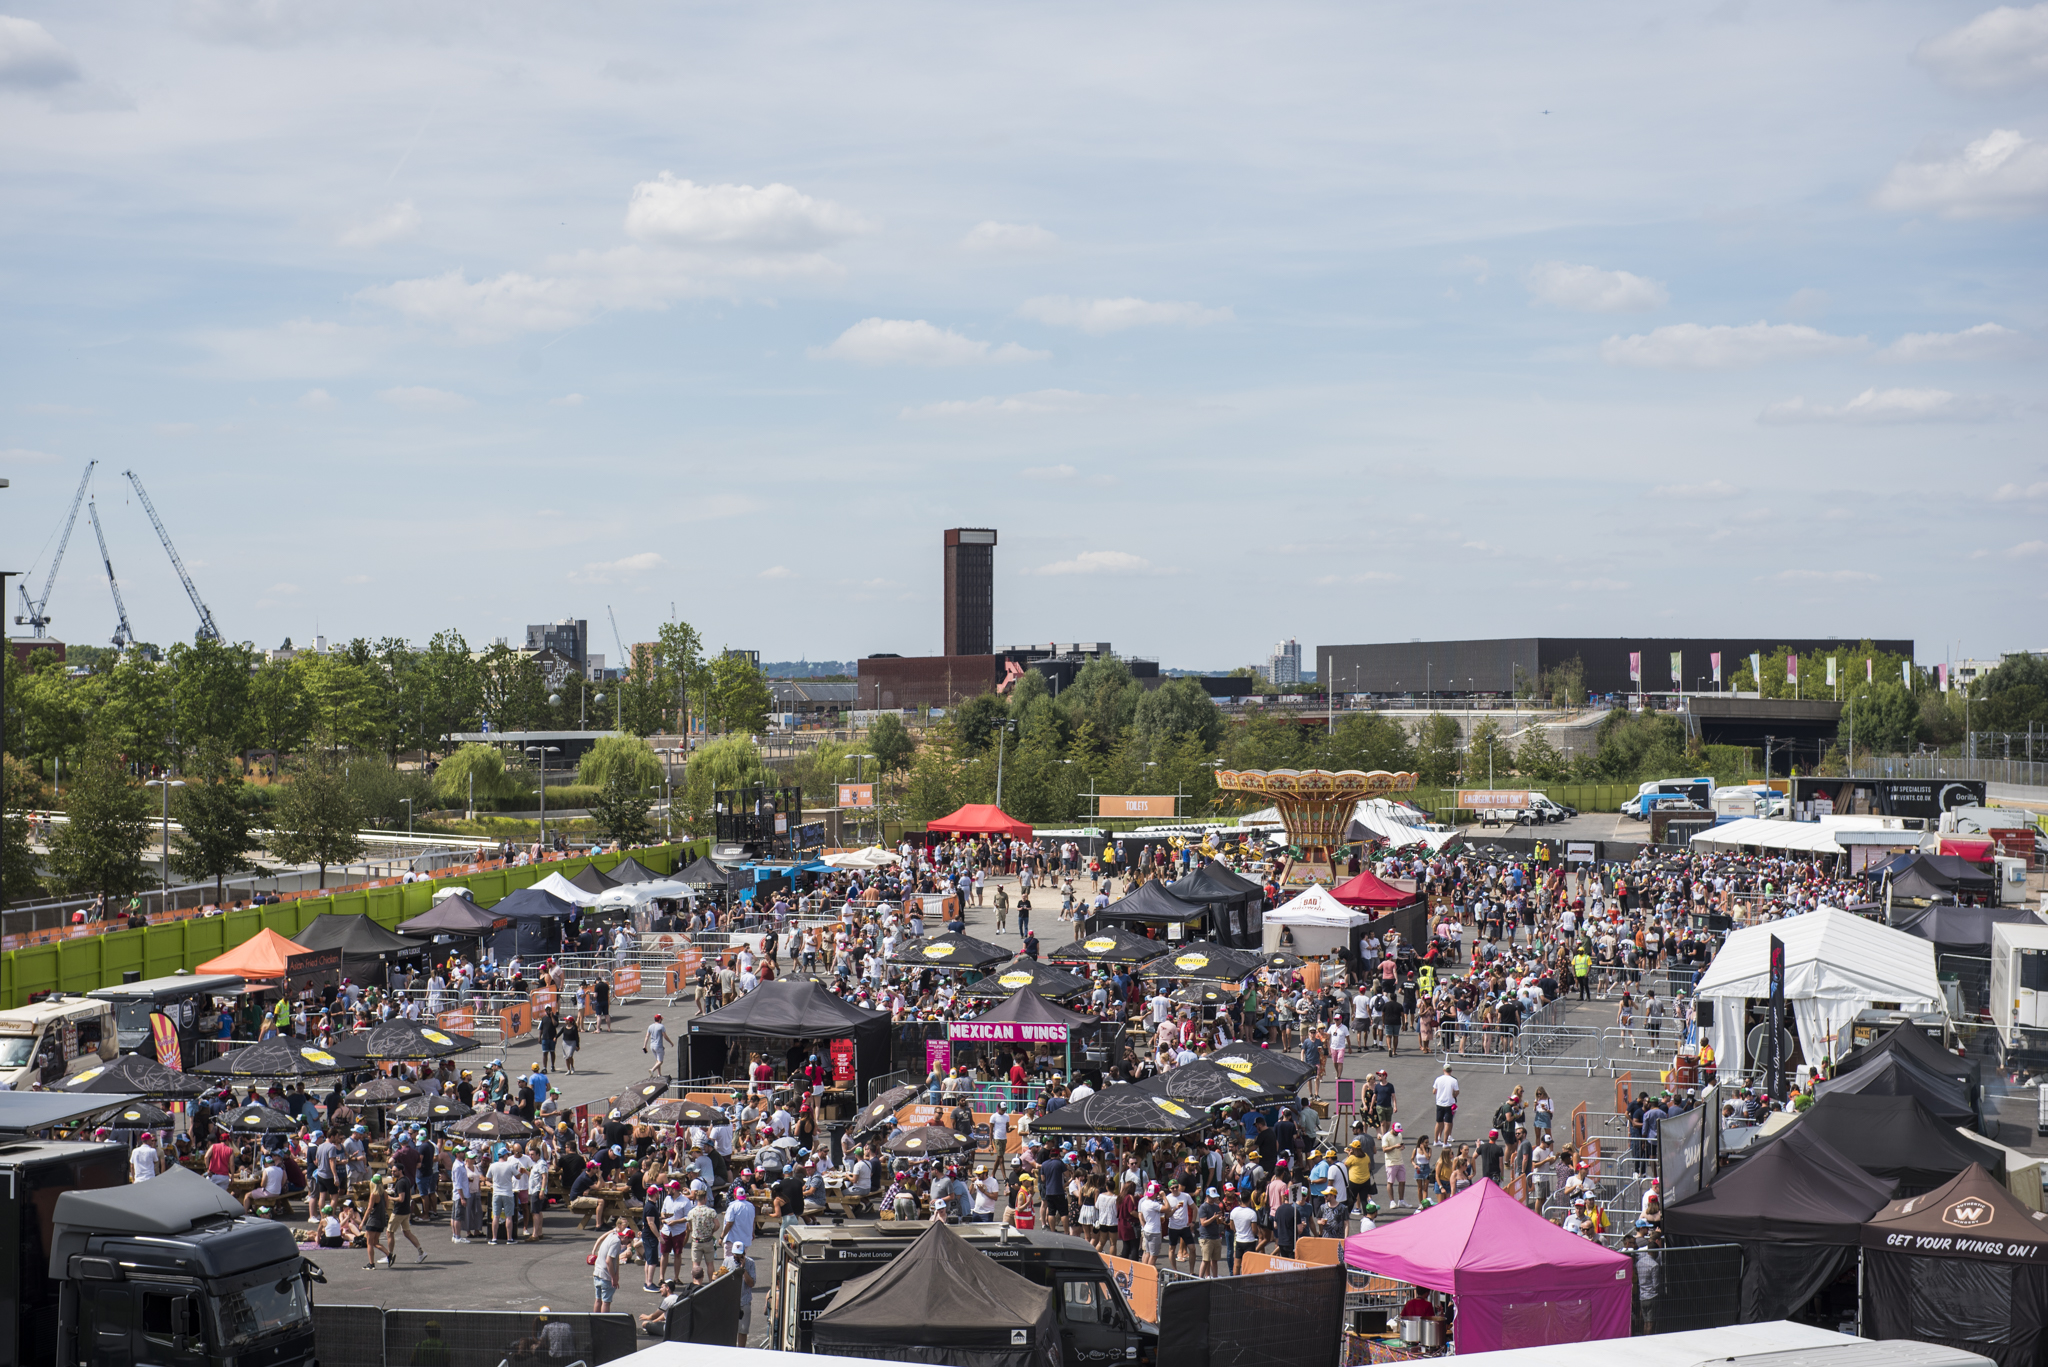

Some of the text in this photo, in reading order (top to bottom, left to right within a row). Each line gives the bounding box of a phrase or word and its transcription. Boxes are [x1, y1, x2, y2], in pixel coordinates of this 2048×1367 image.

[1899, 785, 1931, 793] SPECIALISTS
[1464, 794, 1523, 804] EMERGENCY EXIT ONLY
[1125, 800, 1149, 811] TOILETS
[1303, 898, 1318, 906] BAD
[290, 955, 339, 970] Asian Fried Chicken
[950, 1024, 1067, 1040] MEXICAN WINGS
[1955, 1208, 1983, 1221] W
[1886, 1233, 1913, 1247] GET
[1916, 1236, 1952, 1251] YOUR
[1956, 1238, 2004, 1255] WINGS
